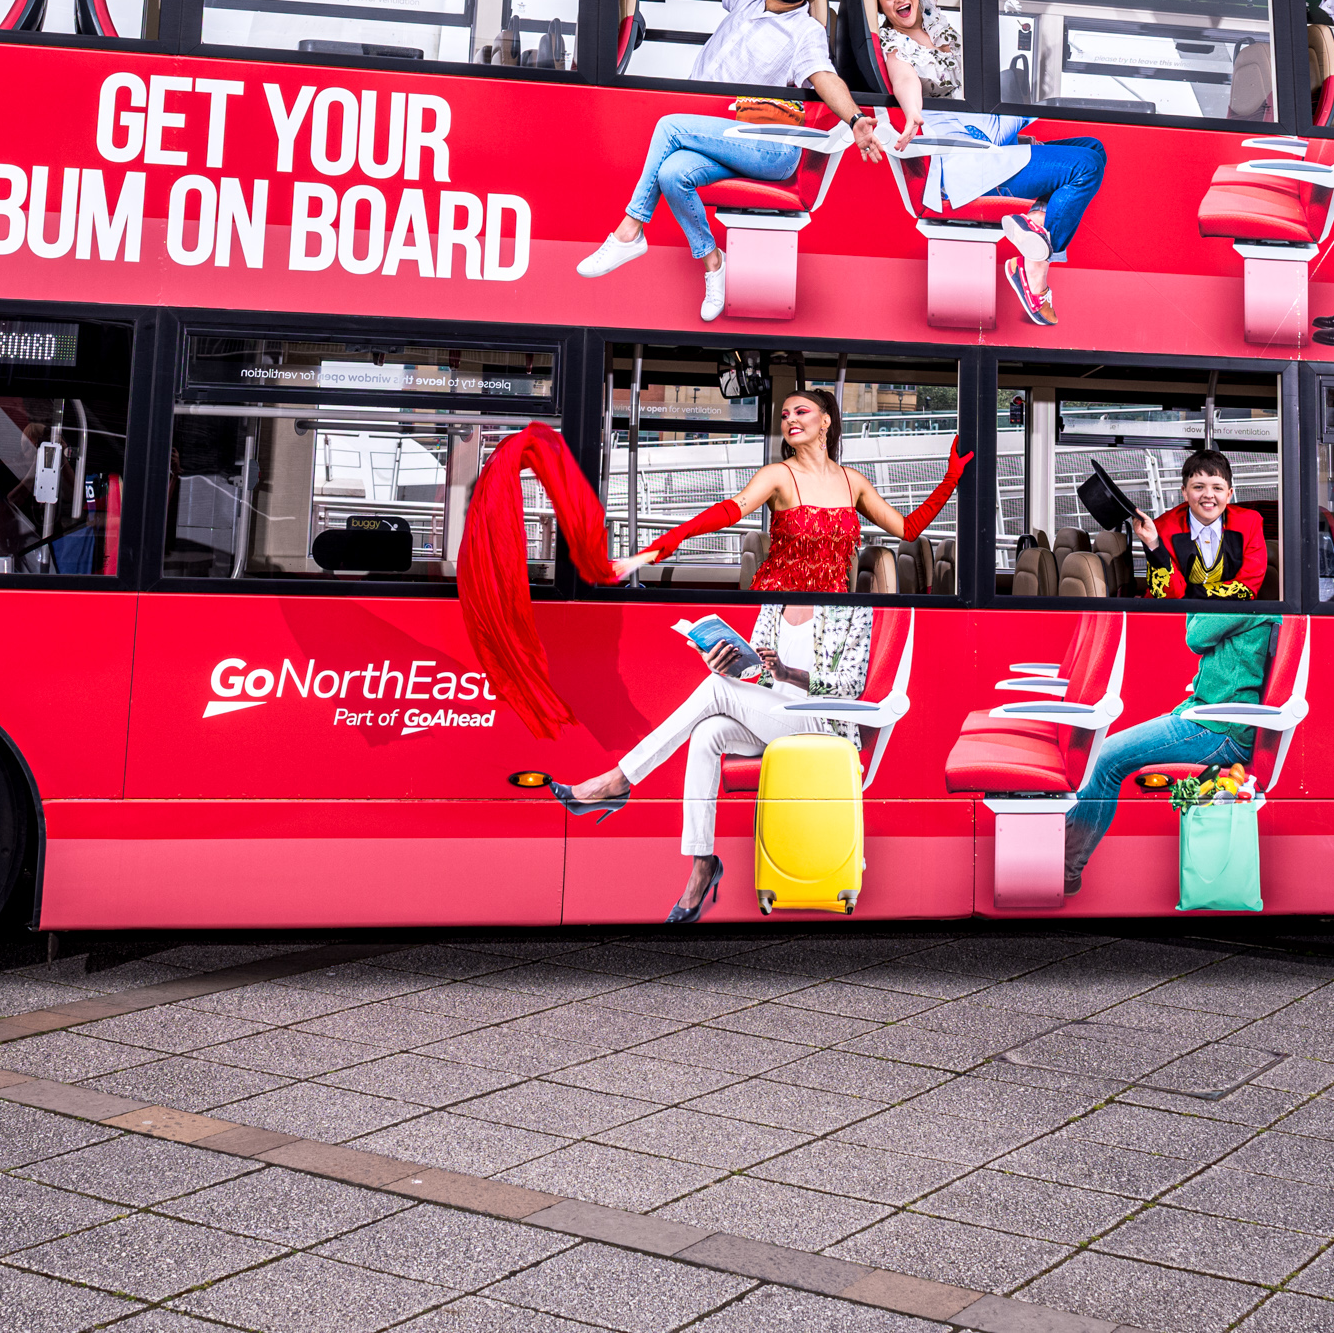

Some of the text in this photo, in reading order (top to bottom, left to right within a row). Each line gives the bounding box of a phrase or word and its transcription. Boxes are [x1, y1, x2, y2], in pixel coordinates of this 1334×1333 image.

[1118, 57, 1130, 65] try
[1137, 57, 1158, 65] leave
[1173, 60, 1194, 68] wind
[97, 72, 452, 183] GET YOUR
[166, 174, 269, 269] ON
[289, 182, 532, 282] BOARD
[613, 403, 722, 415] winw open for ventilation
[1182, 426, 1202, 434] ndow
[1234, 428, 1271, 436] ventilation
[351, 518, 381, 529] buggy
[333, 708, 496, 728] Part of GoAhead
